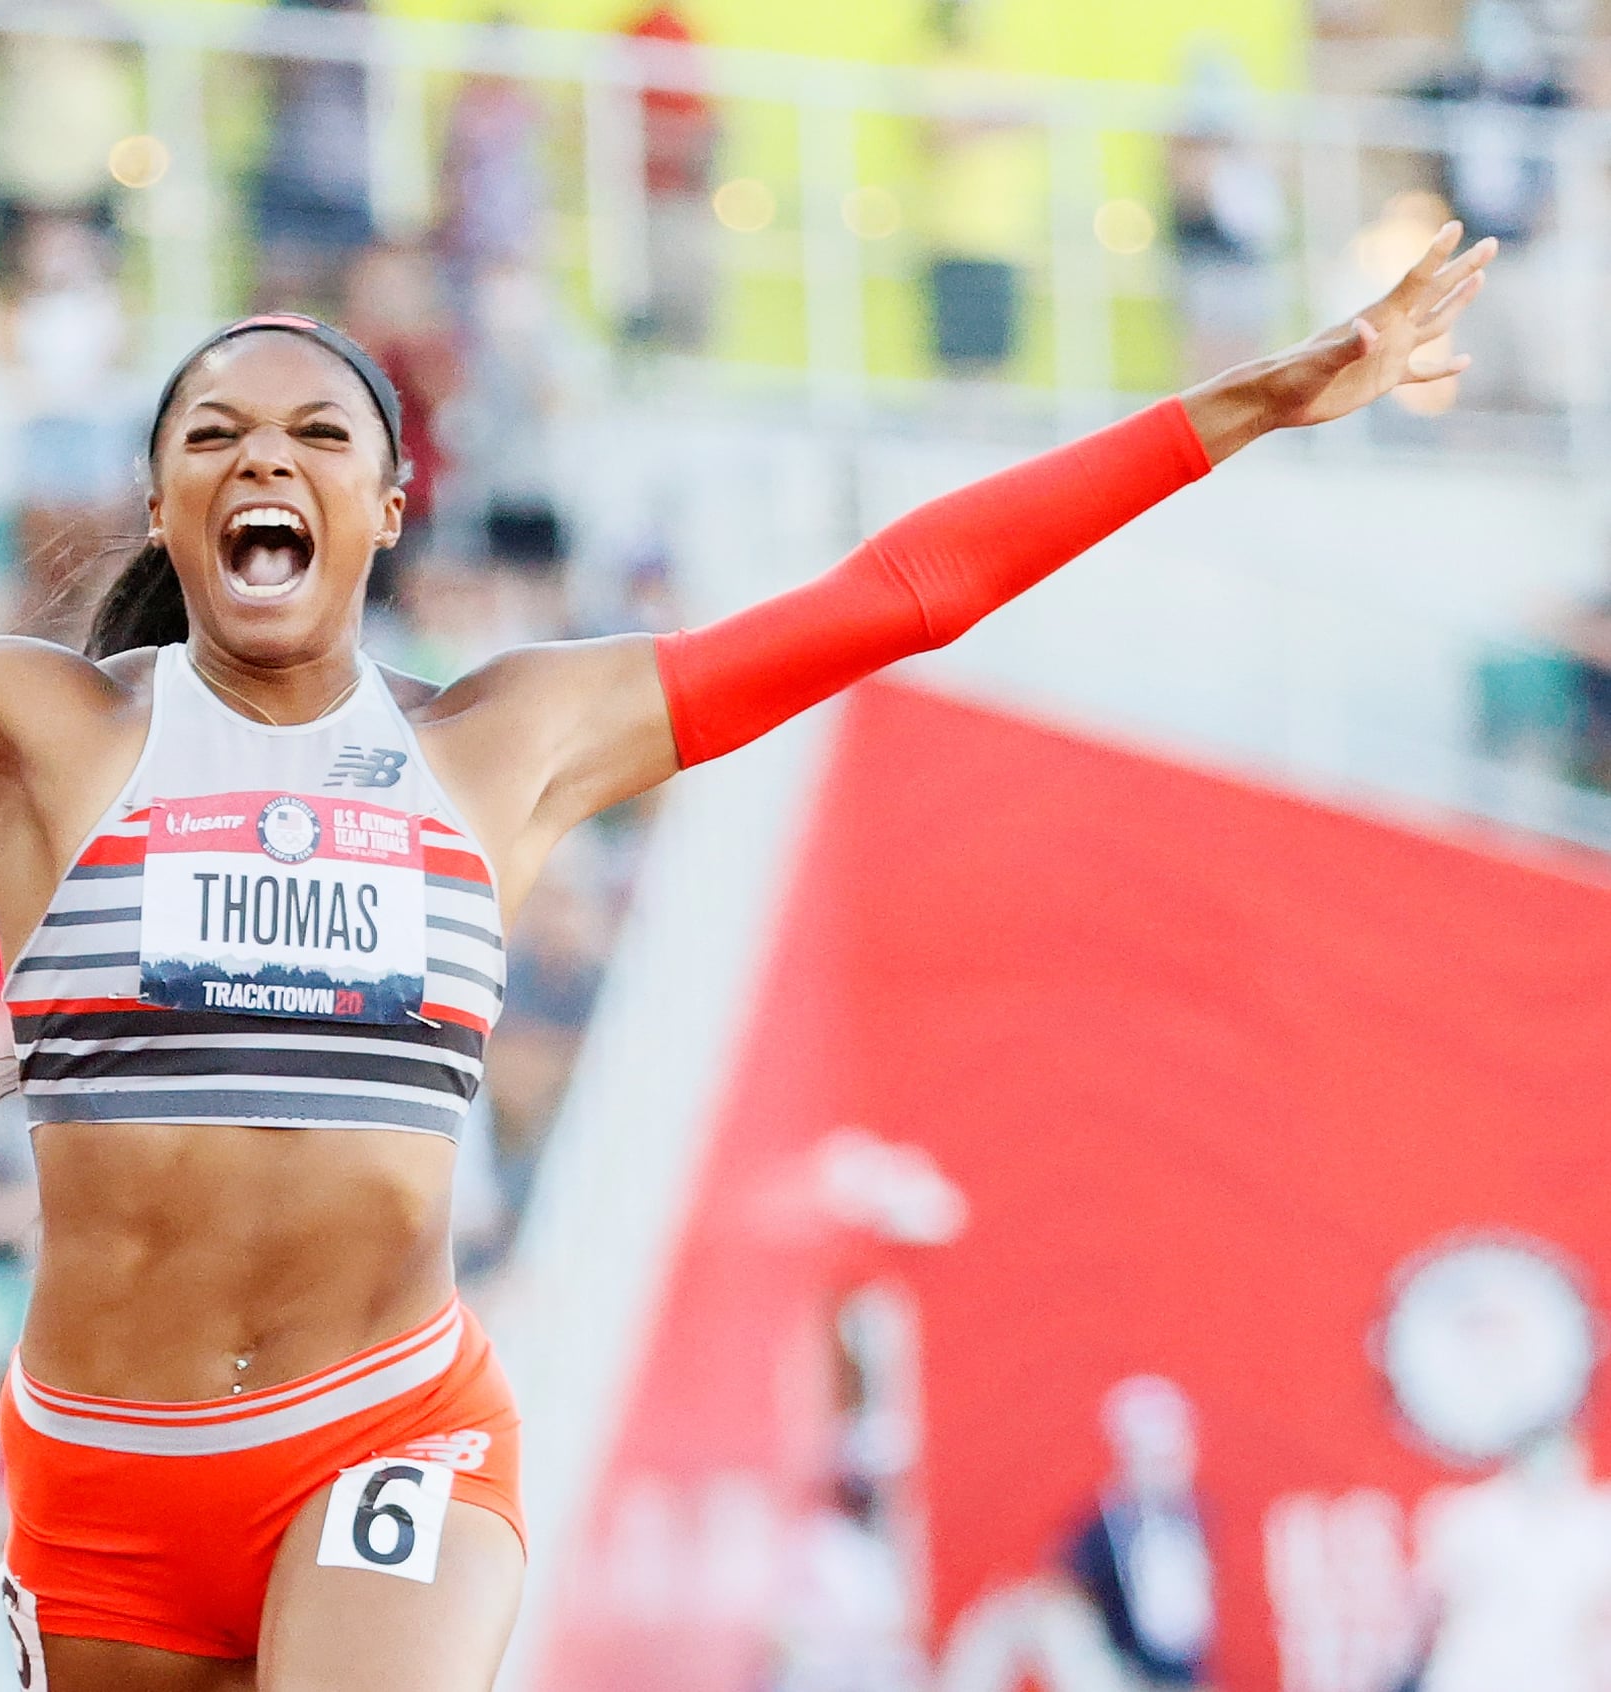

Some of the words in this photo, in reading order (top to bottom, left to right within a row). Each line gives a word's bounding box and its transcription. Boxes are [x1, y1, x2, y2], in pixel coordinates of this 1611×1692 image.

[189, 815, 247, 833] USATF
[333, 827, 369, 849] TEAM
[193, 872, 379, 954] THOMAS
[351, 1464, 424, 1566] 6
